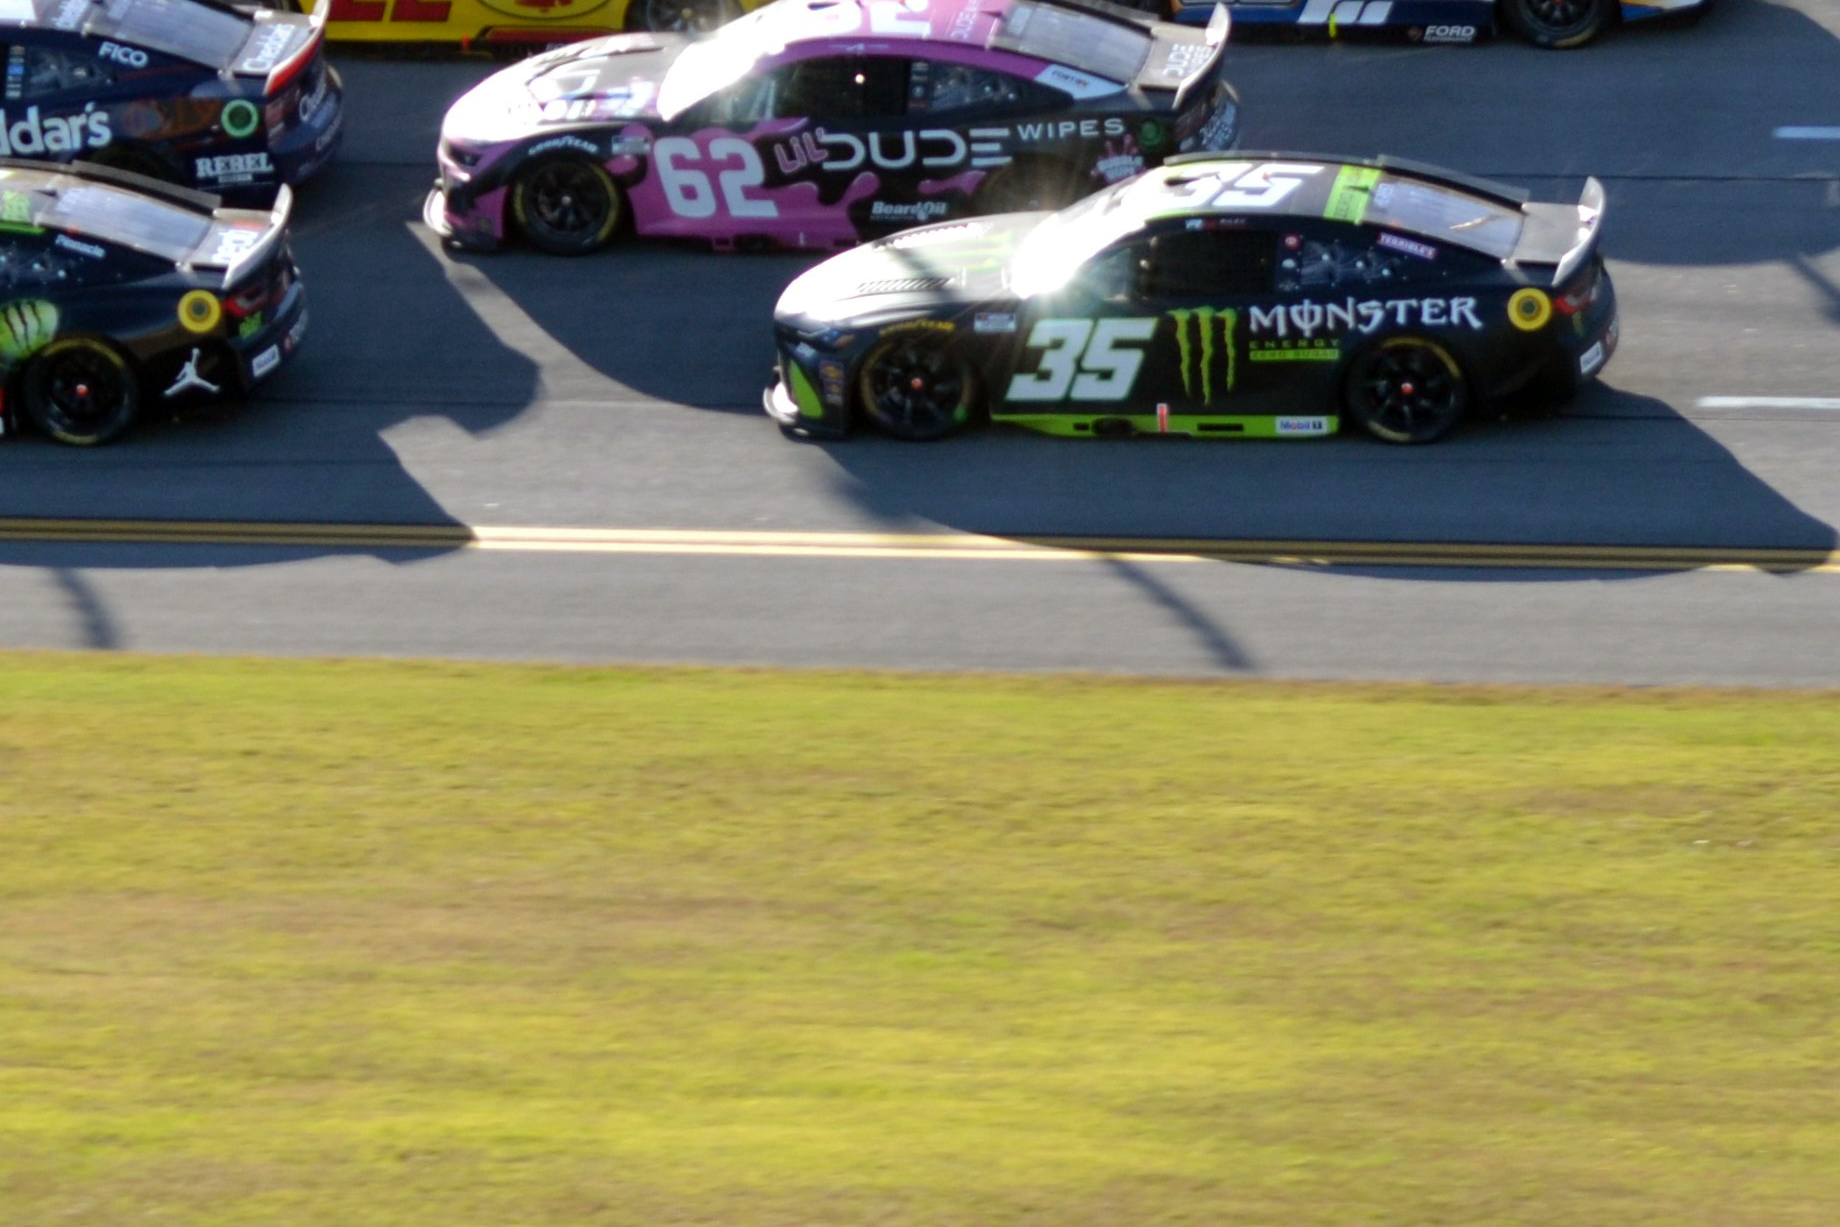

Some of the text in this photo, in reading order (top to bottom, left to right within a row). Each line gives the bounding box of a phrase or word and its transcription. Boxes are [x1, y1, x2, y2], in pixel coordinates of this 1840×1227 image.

[1424, 25, 1476, 39] FORD
[99, 41, 149, 68] FICO
[1017, 117, 1126, 141] WIPES
[822, 128, 1013, 170] DUDE
[195, 152, 275, 178] REBEL
[653, 136, 779, 218] 62
[870, 200, 918, 216] Beard
[54, 234, 107, 259] Pinnacle
[1249, 339, 1340, 349] ENERGY
[1004, 316, 1159, 402] 35
[1279, 420, 1311, 431] Mobil
